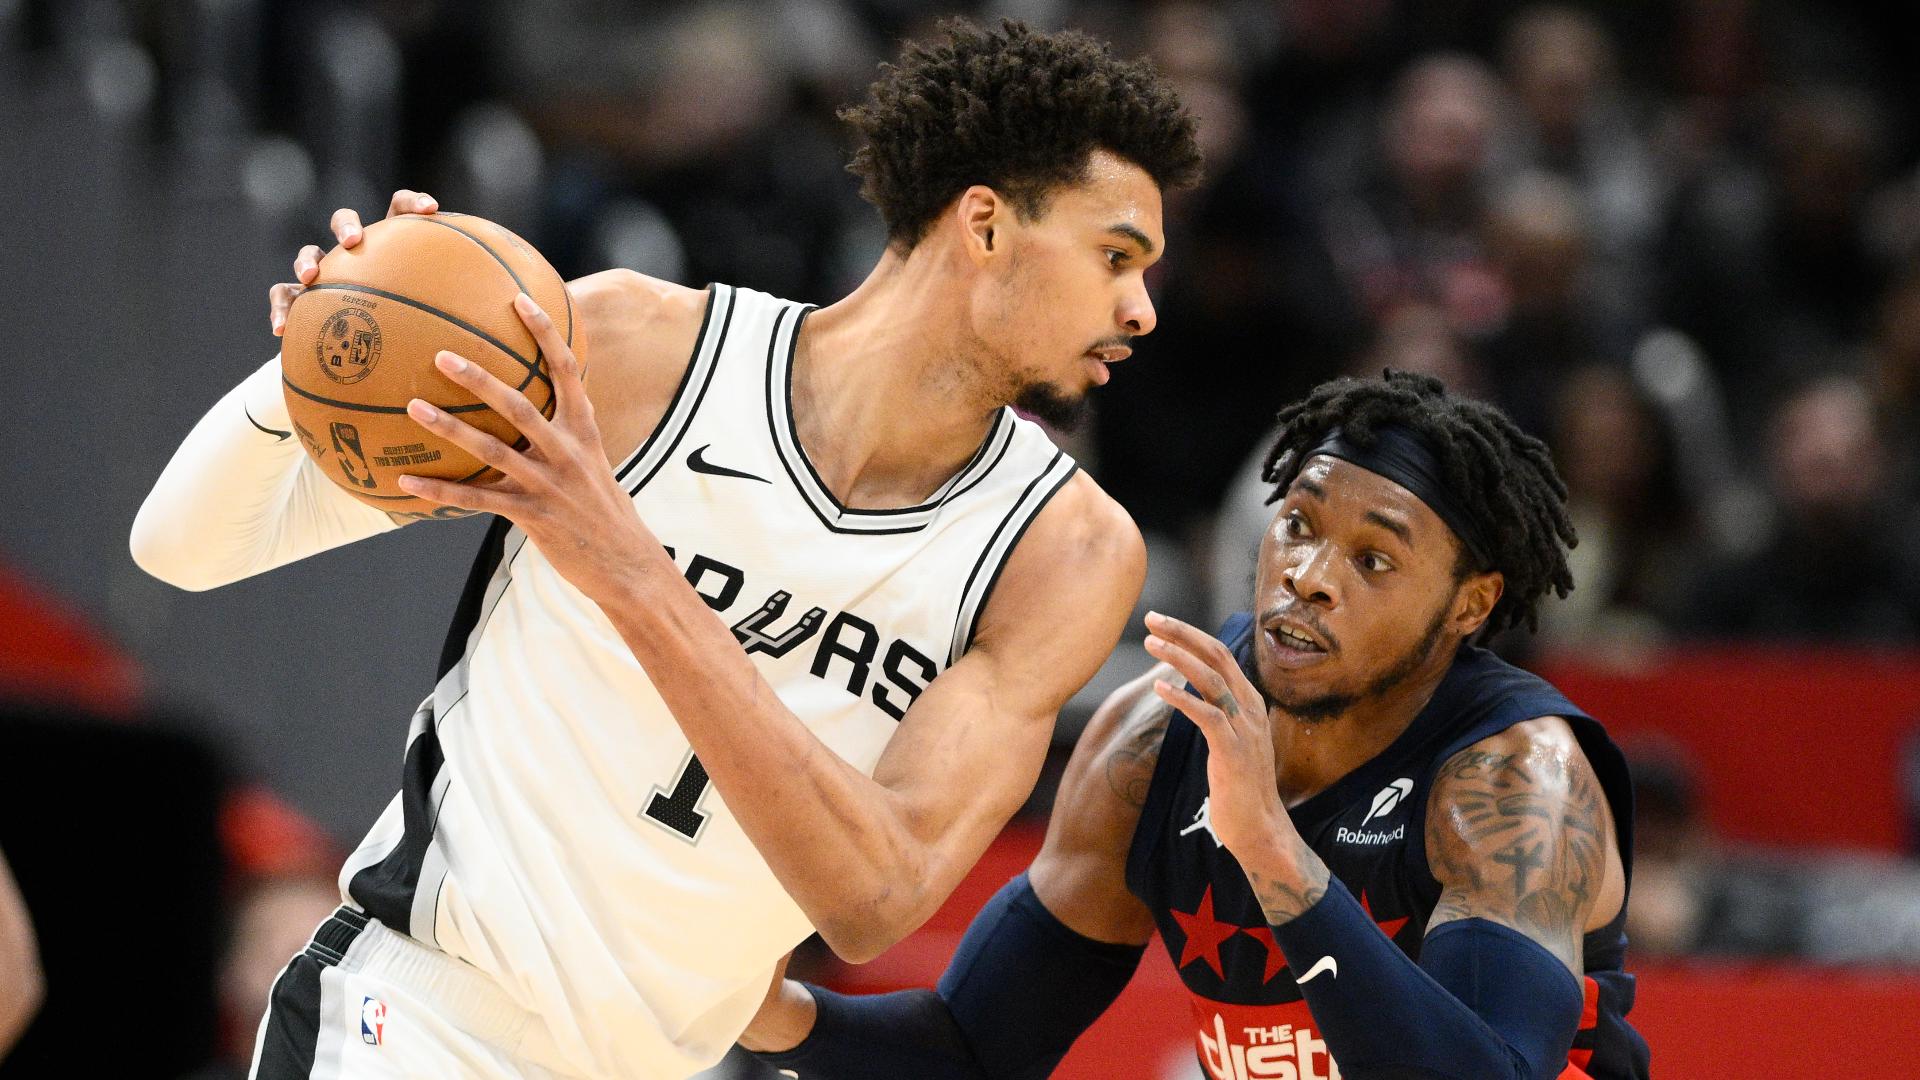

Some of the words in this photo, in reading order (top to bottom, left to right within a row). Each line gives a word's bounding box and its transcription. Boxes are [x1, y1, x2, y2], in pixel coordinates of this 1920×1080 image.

[373, 457, 390, 467] BALL
[390, 456, 411, 466] GAME
[409, 450, 442, 464] OFFICIAL
[663, 545, 938, 723] PURS
[1244, 1024, 1293, 1044] THE
[1200, 1013, 1342, 1080] dist
